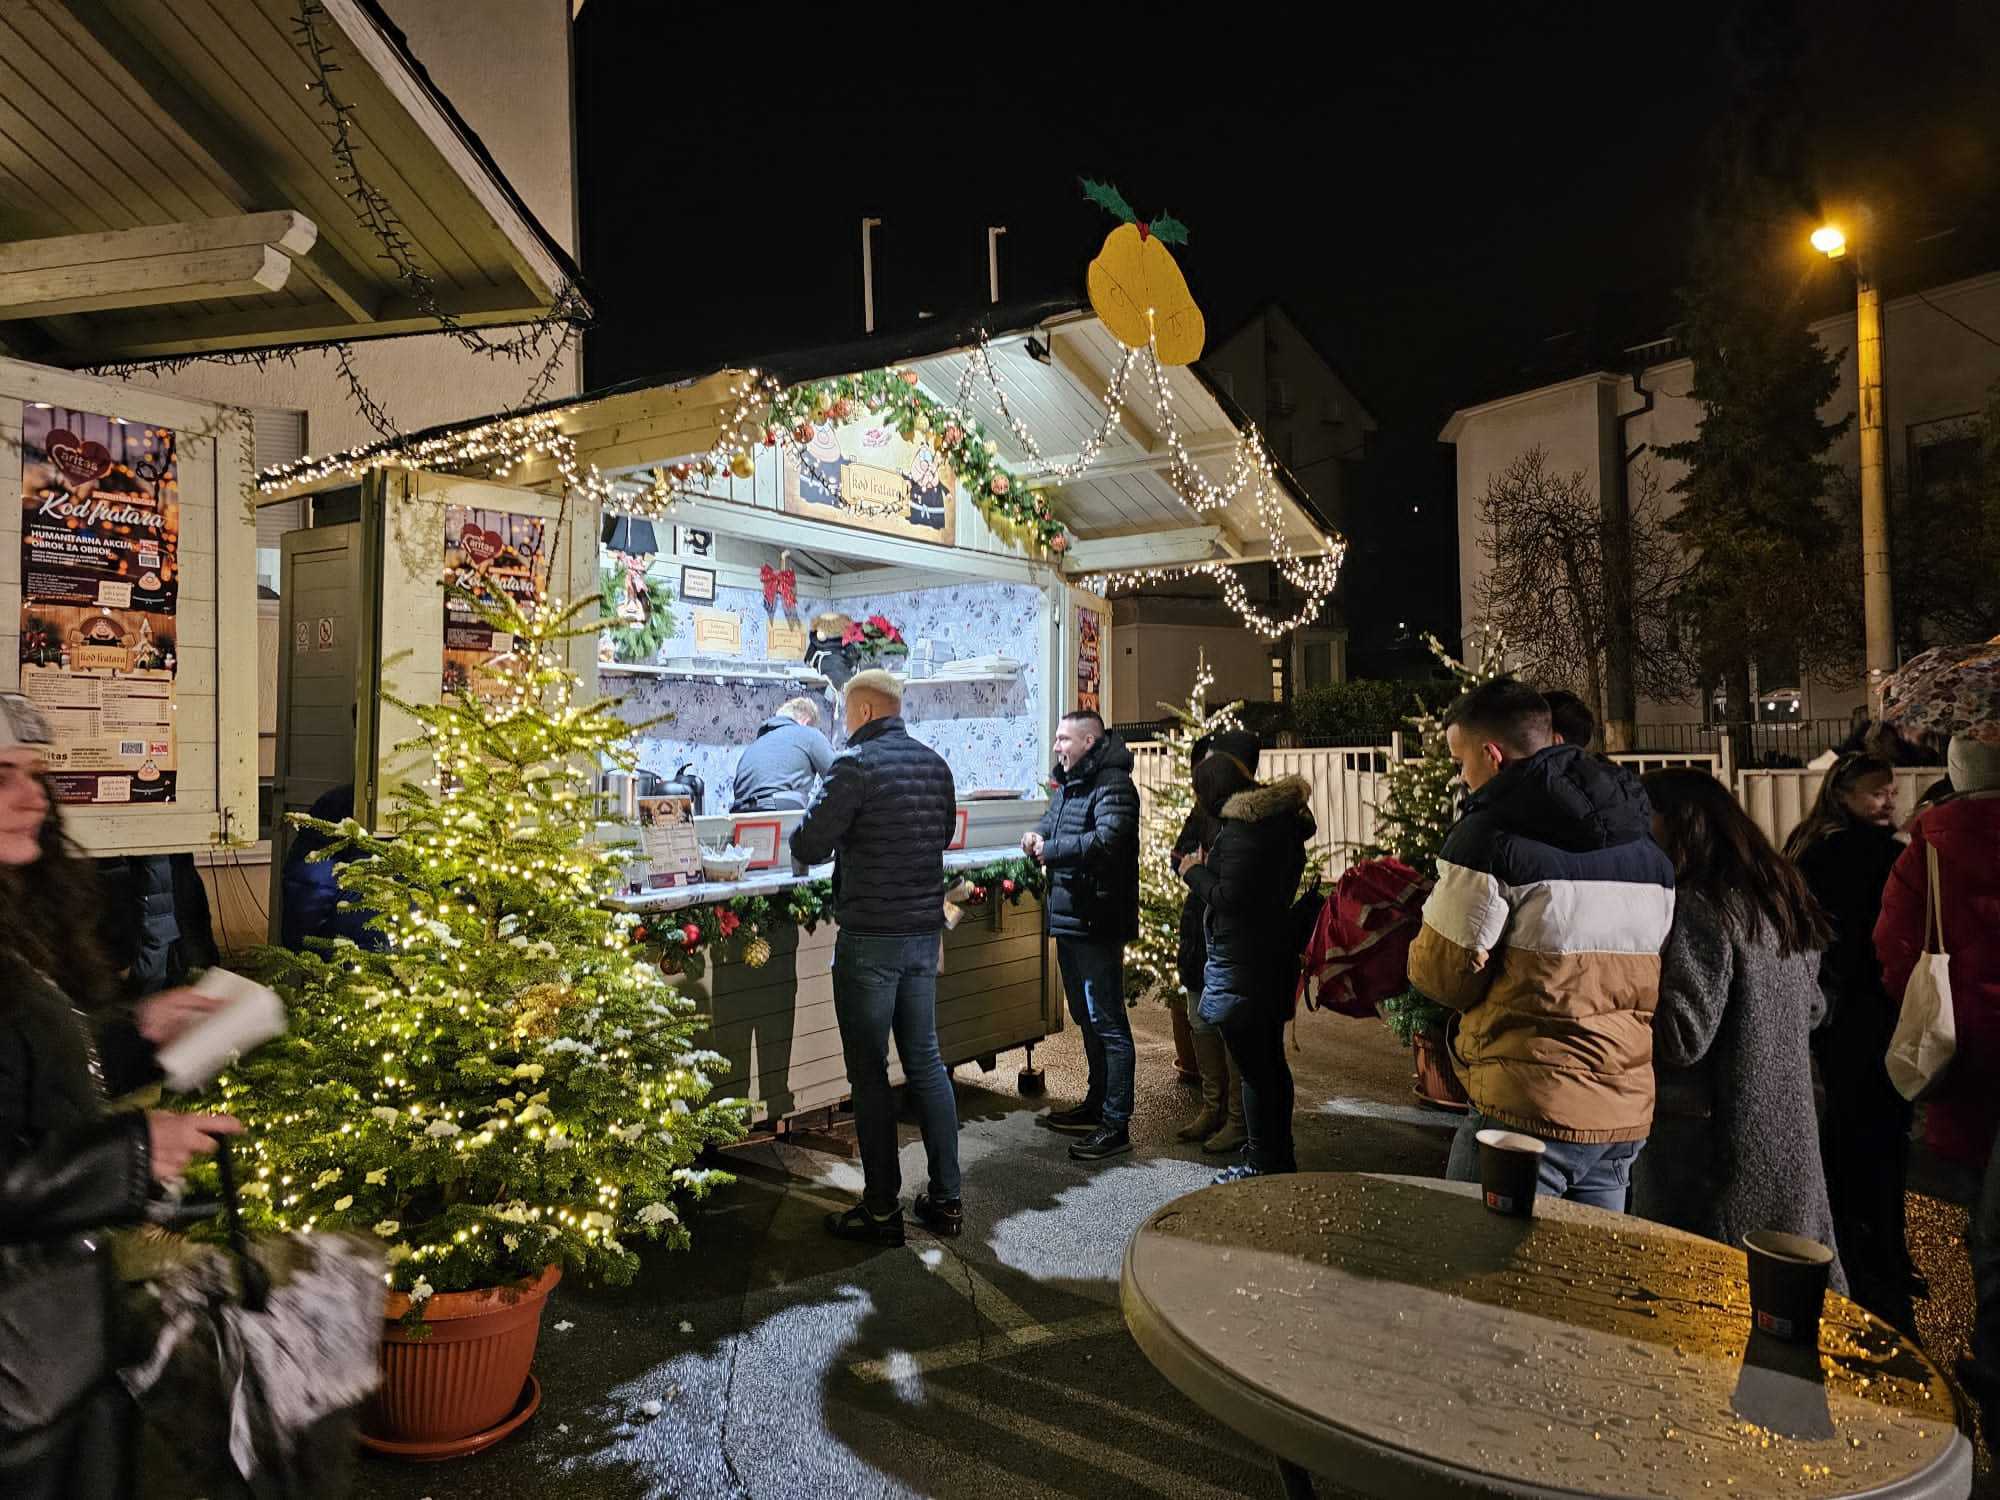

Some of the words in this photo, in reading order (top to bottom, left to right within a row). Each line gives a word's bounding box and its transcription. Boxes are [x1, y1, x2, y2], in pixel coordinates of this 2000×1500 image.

[39, 492, 91, 520] Kod
[87, 500, 164, 528] fratara
[31, 530, 102, 546] HUMANITARNA
[103, 539, 134, 550] AKCIJA
[31, 541, 64, 551] OBROK
[66, 543, 79, 552] ZA
[80, 545, 111, 556] OBROK
